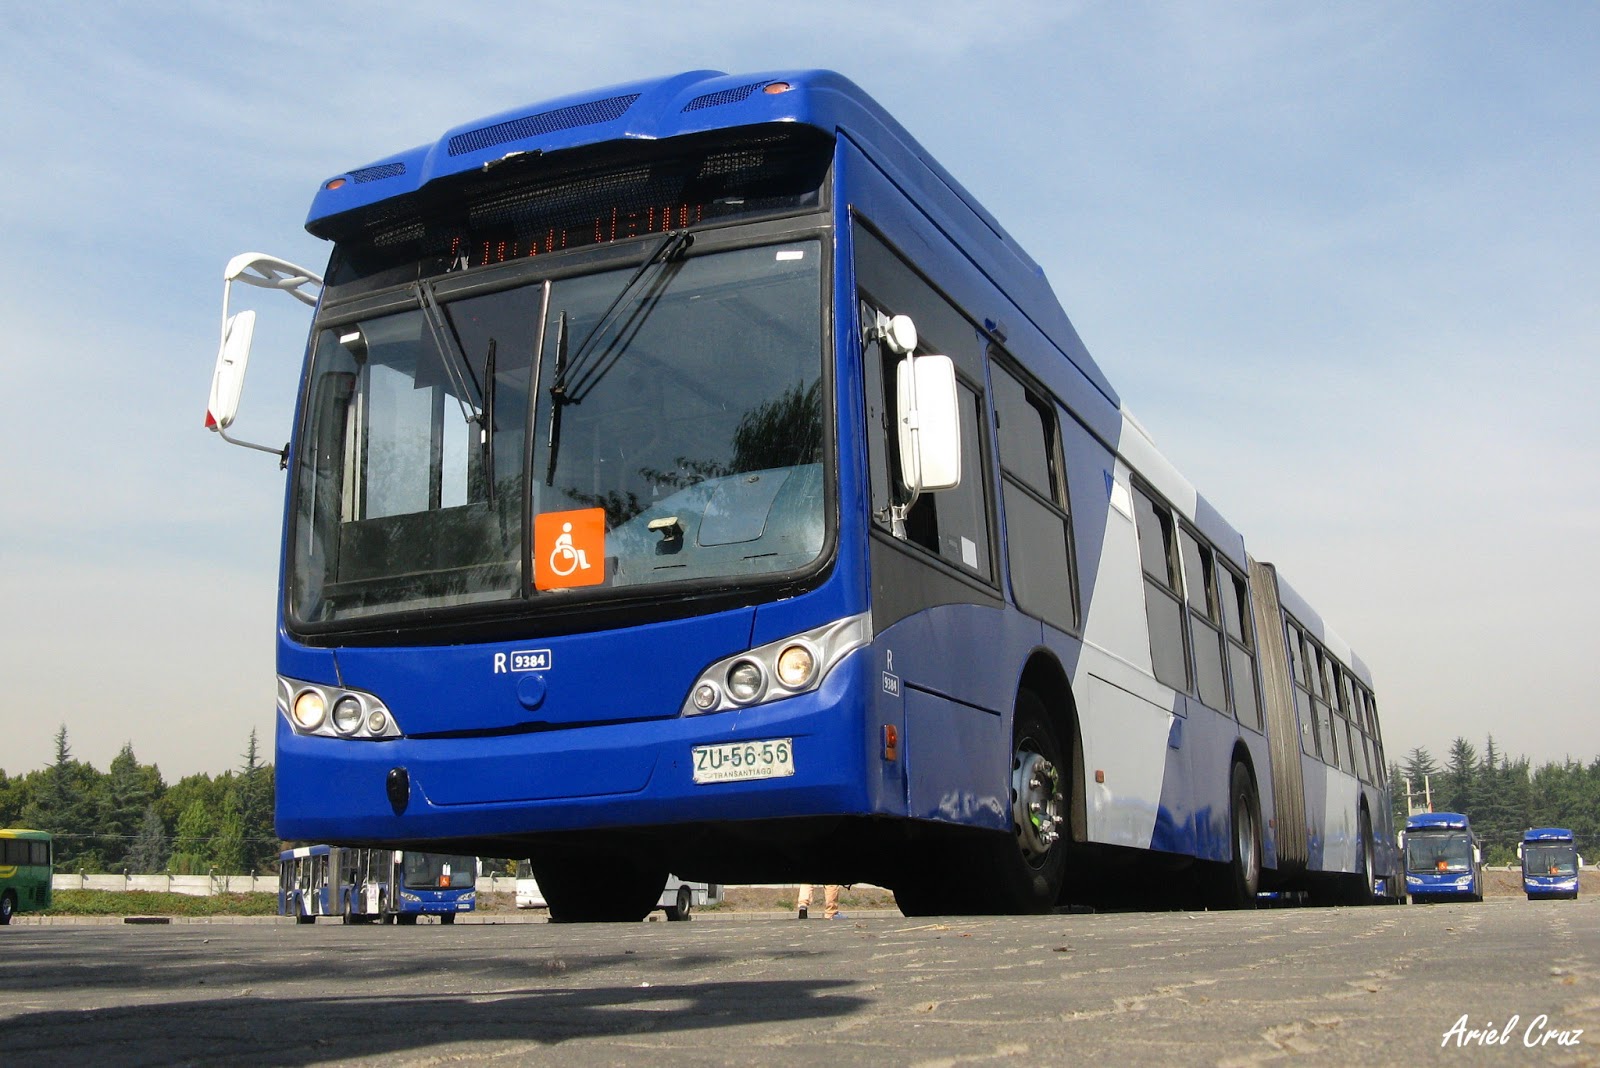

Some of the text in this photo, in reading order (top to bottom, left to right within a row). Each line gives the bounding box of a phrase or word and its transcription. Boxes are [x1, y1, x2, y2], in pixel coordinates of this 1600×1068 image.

[494, 652, 545, 674] R 9384
[886, 649, 893, 671] R
[713, 767, 772, 779] TRANSANTIAGO
